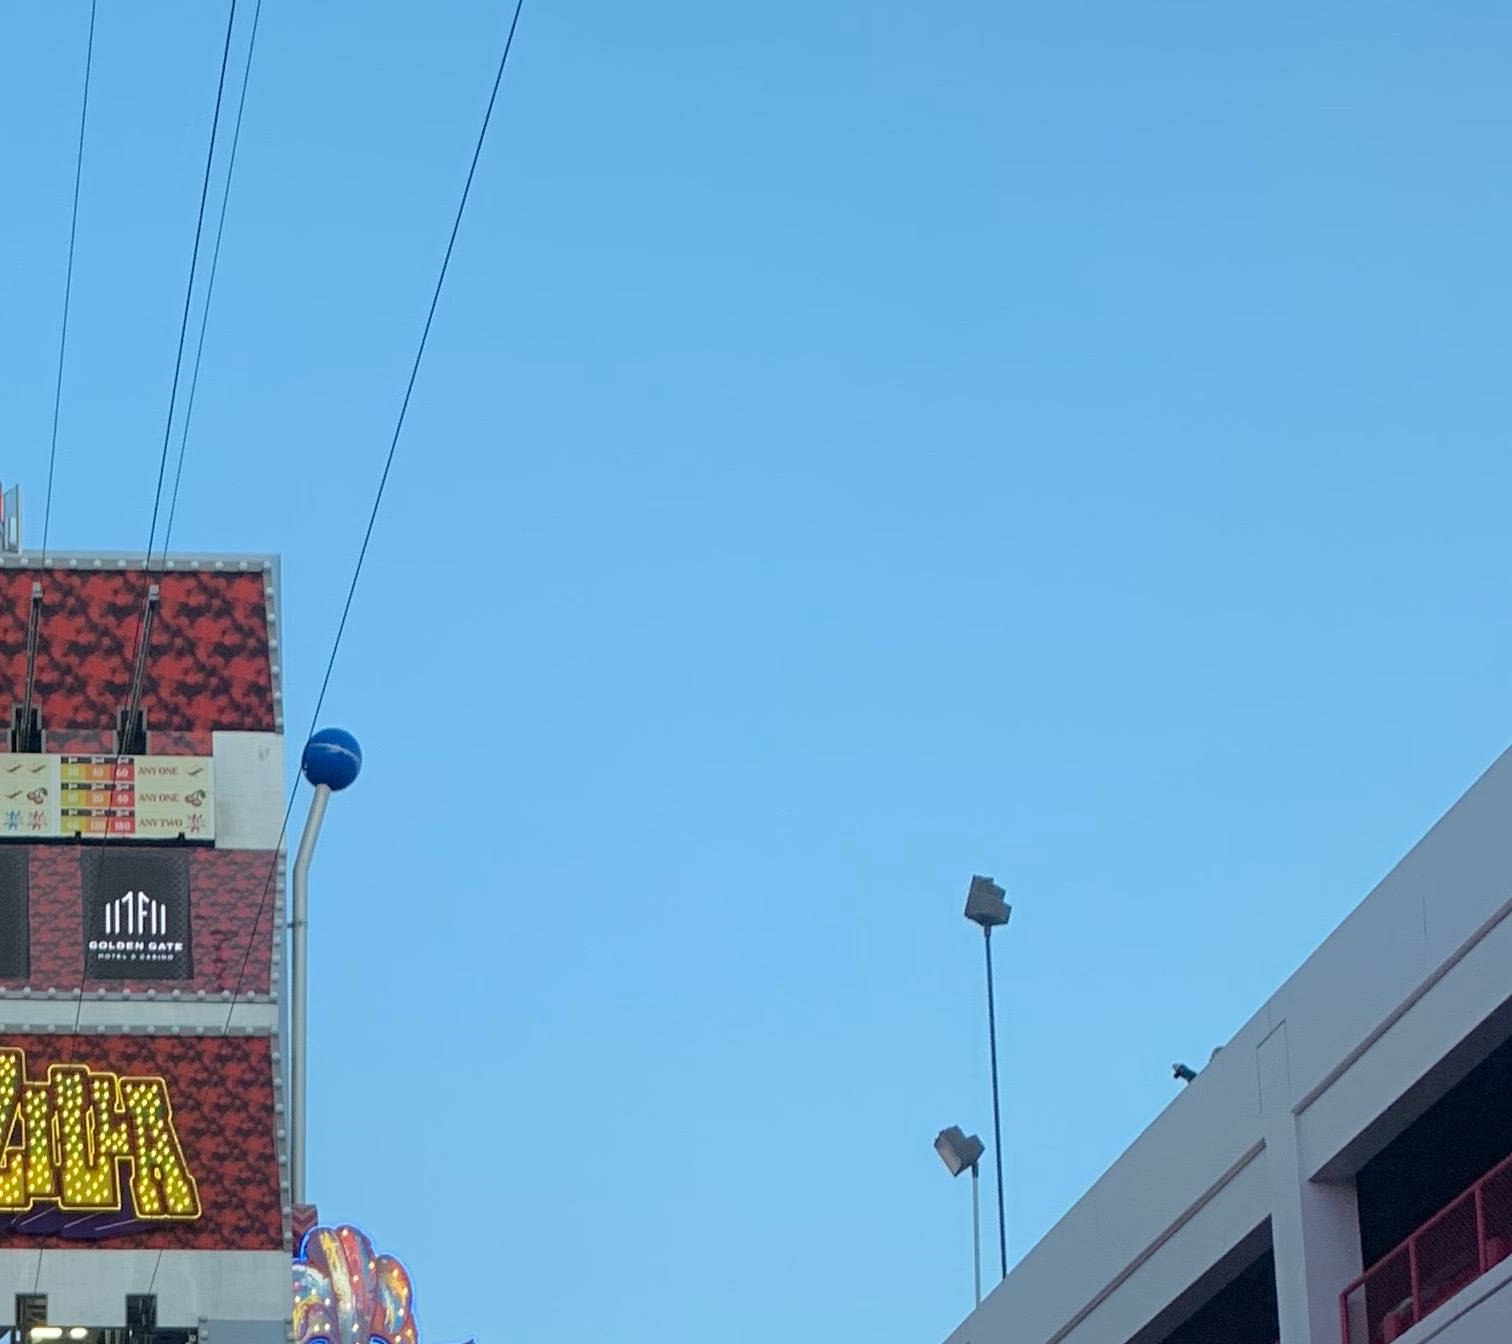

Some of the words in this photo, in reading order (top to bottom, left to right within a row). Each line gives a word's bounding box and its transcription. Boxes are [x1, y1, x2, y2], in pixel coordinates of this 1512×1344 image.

[116, 768, 129, 777] 60
[138, 766, 157, 776] ANY
[157, 766, 178, 776] ONE
[116, 795, 130, 804] 40
[139, 793, 158, 803] ANY
[158, 794, 179, 803] ONE
[139, 819, 159, 828] ANY
[159, 819, 184, 828] TWO
[89, 941, 144, 951] GOLDEN
[148, 941, 183, 952] GATE
